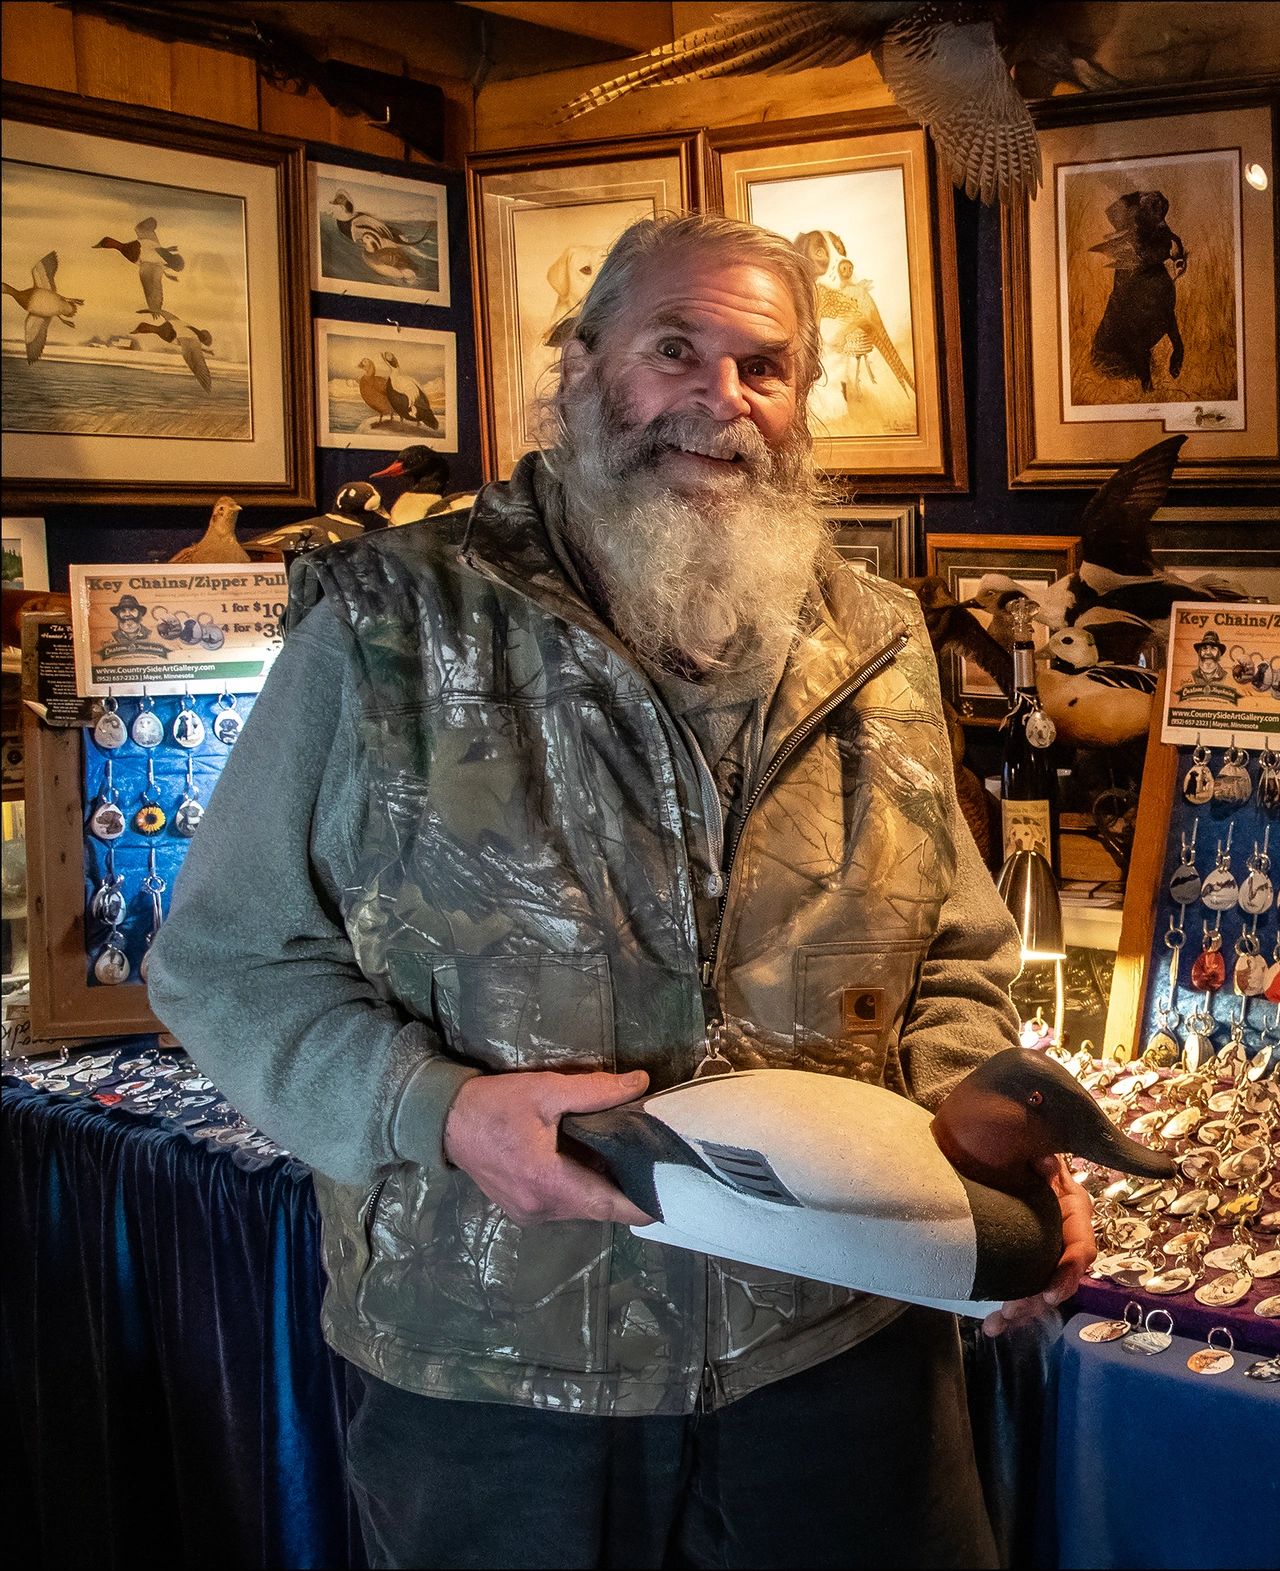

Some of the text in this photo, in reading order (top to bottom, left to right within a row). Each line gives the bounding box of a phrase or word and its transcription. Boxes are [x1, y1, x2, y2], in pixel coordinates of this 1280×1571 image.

[88, 574, 287, 593] Key Chains/Zipper Pull
[221, 601, 285, 618] 1 for $10
[1179, 611, 1209, 628] Key
[221, 623, 230, 633] 4
[233, 623, 251, 633] for
[96, 664, 216, 675] www.CountrySideArtGallery.com
[164, 673, 195, 681] Minnesota
[1171, 710, 1280, 723] www.CountrySideArtGallery.com
[1230, 722, 1259, 730] Minnesota
